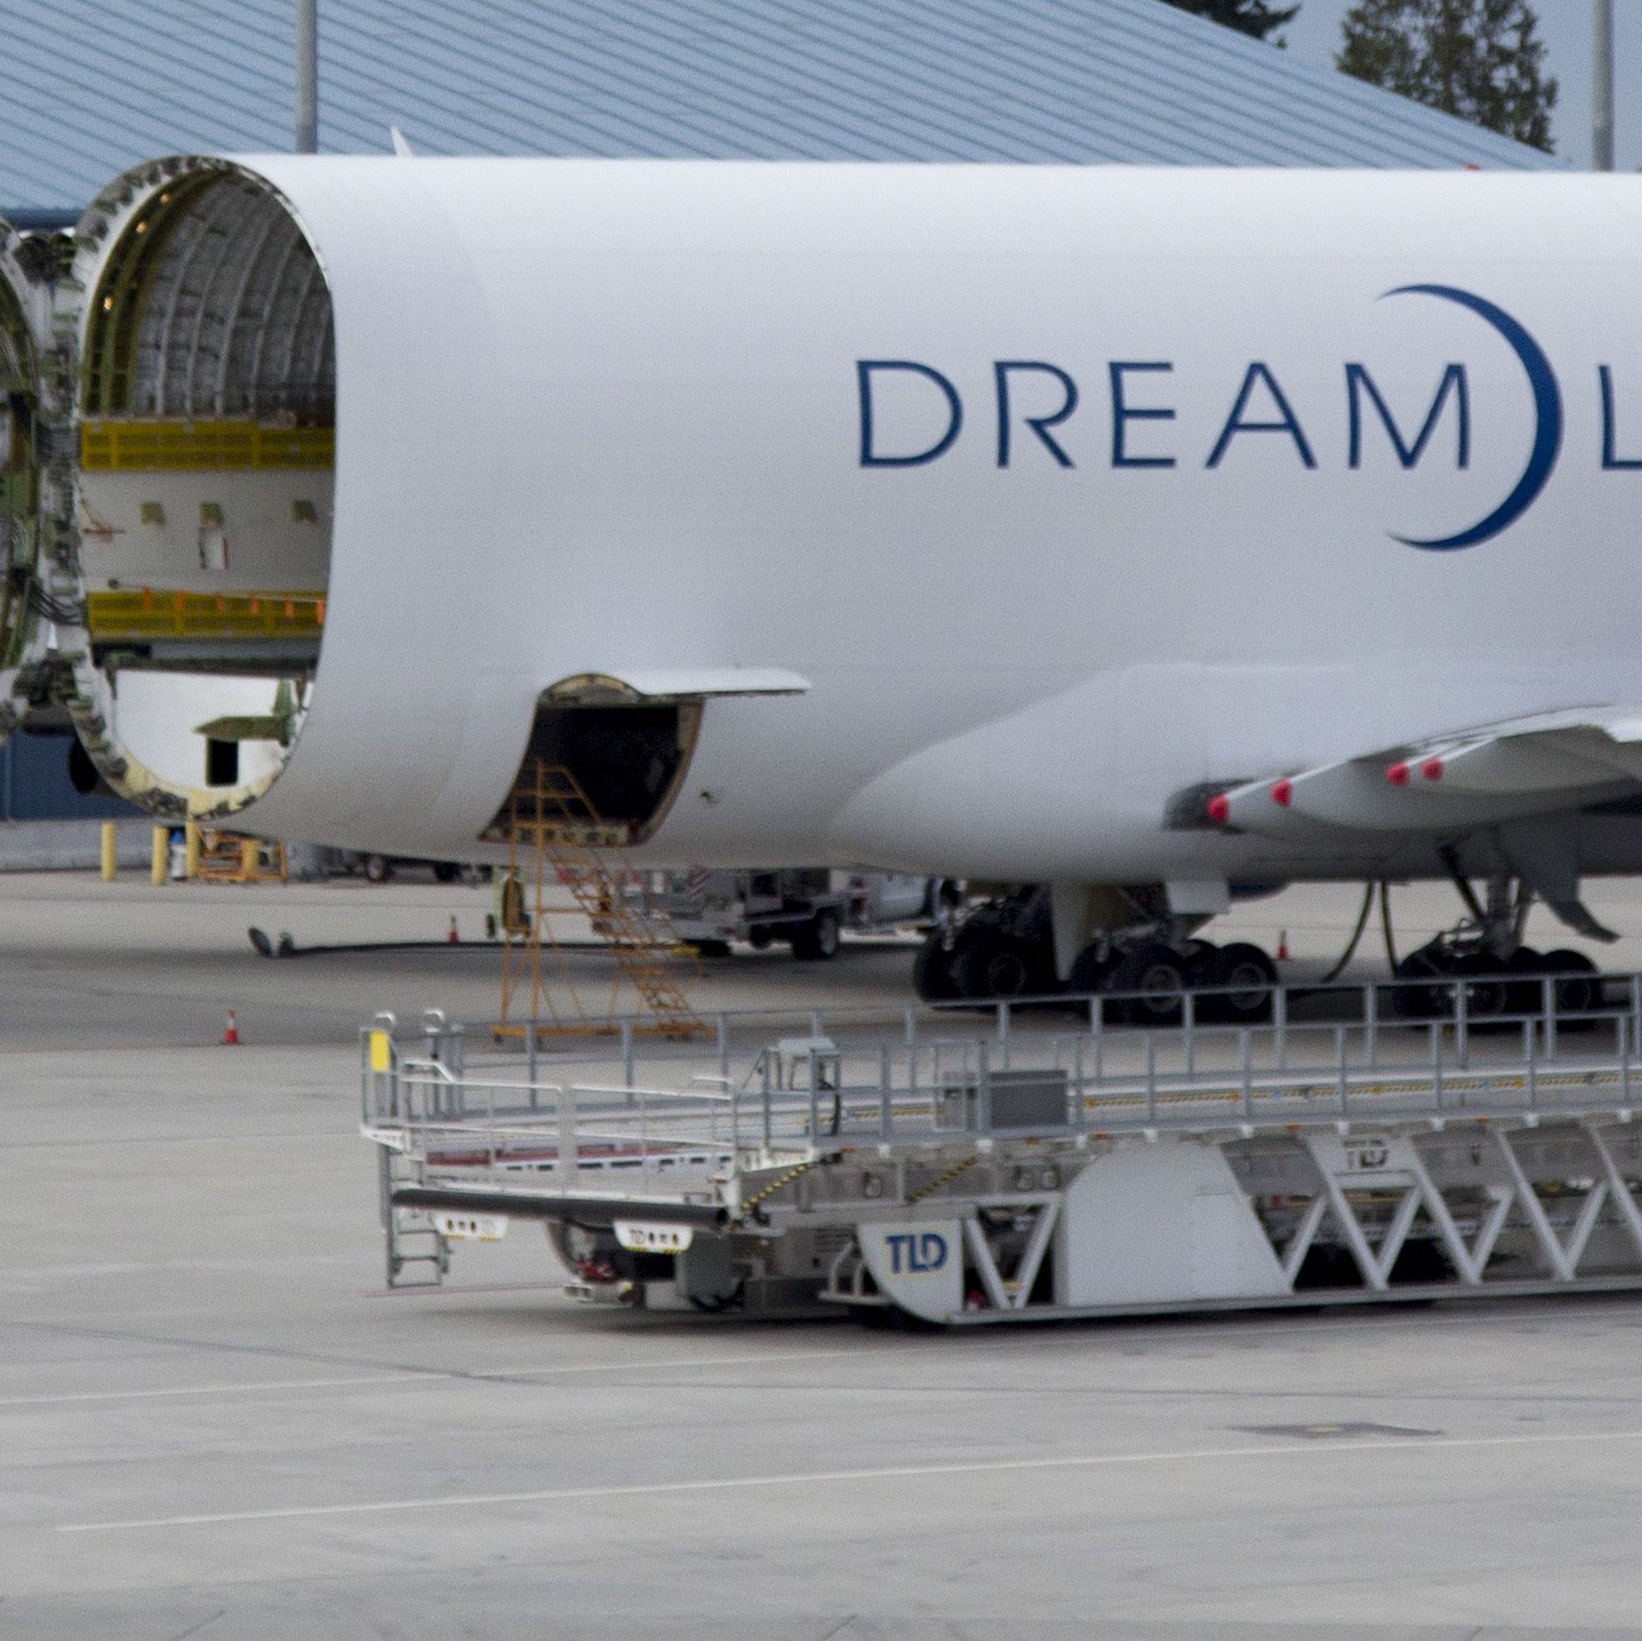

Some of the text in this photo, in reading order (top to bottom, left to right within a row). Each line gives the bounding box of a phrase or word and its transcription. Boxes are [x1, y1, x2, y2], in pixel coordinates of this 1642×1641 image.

[855, 359, 1470, 470] DREAM
[1342, 1139, 1390, 1170] TLD
[885, 1232, 949, 1274] TLD
